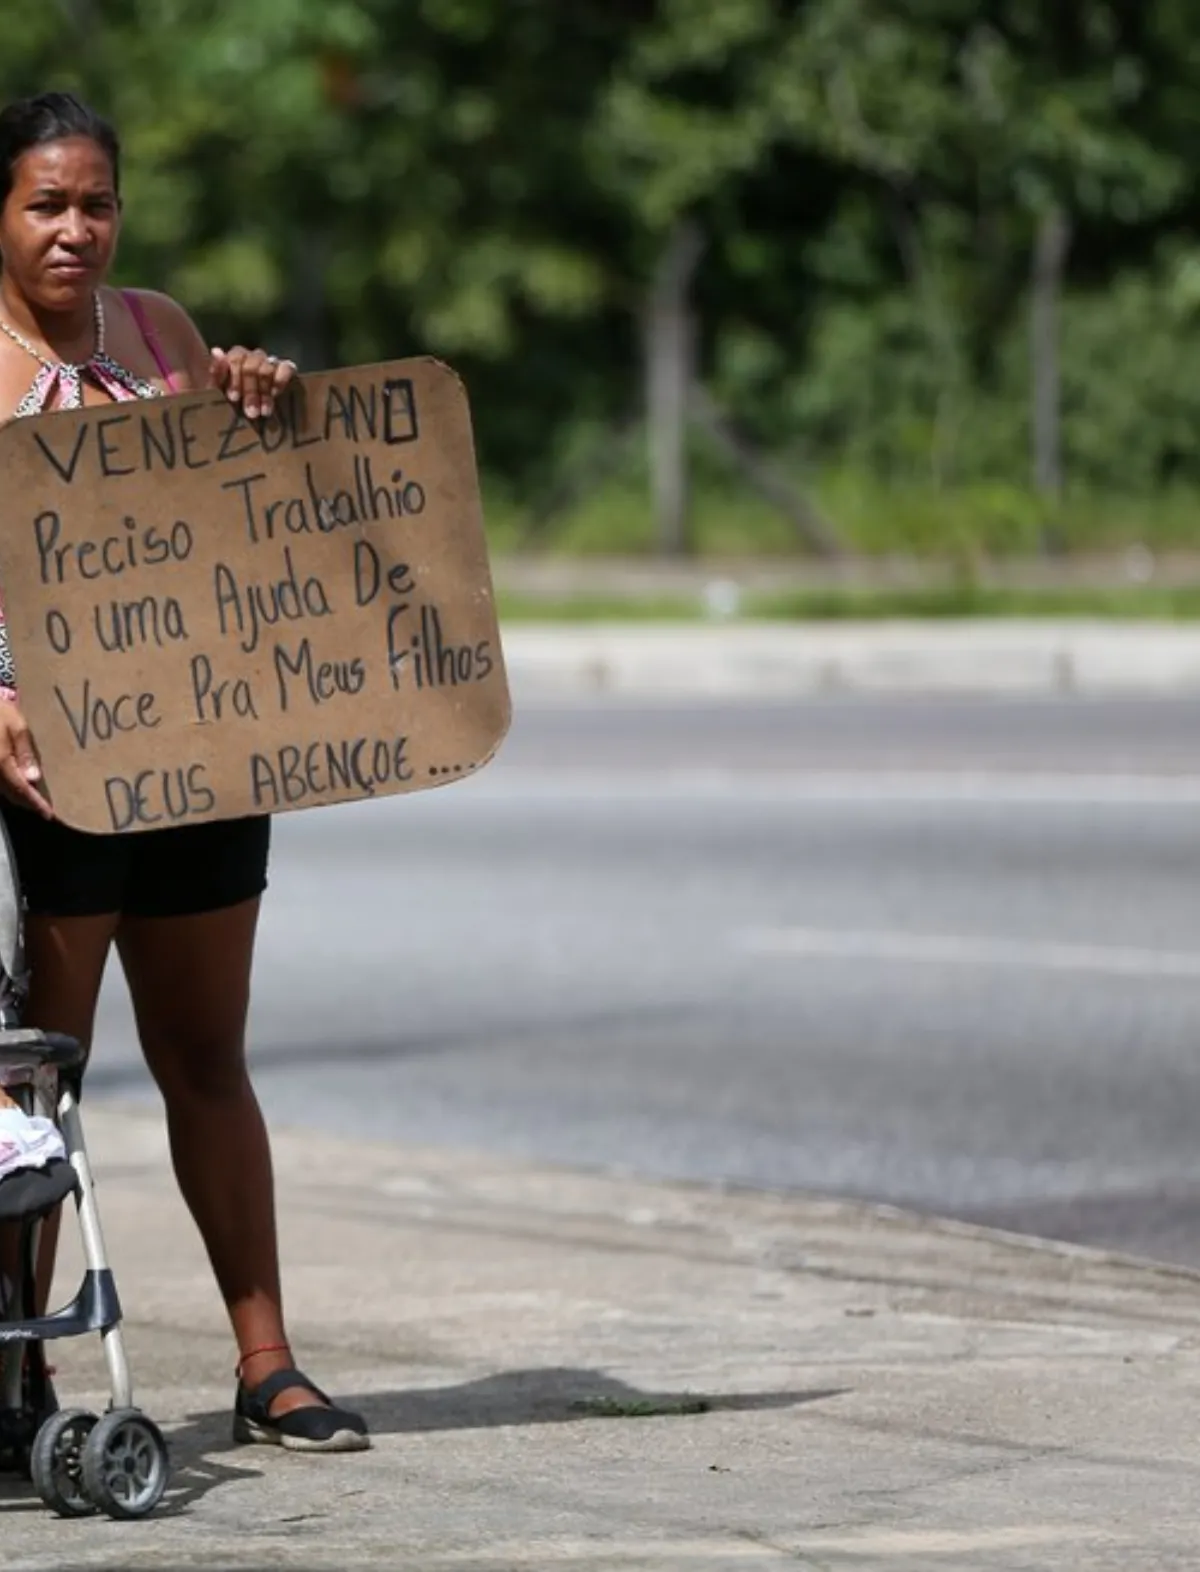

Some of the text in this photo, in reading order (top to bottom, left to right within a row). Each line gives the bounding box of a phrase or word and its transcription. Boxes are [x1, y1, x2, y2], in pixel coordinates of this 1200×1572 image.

[34, 510, 193, 584] Preciso
[214, 547, 330, 654] Ajuda
[354, 540, 416, 608] De
[54, 602, 494, 750] Voce Pra Meus Filhos
[104, 764, 216, 832] DEUS
